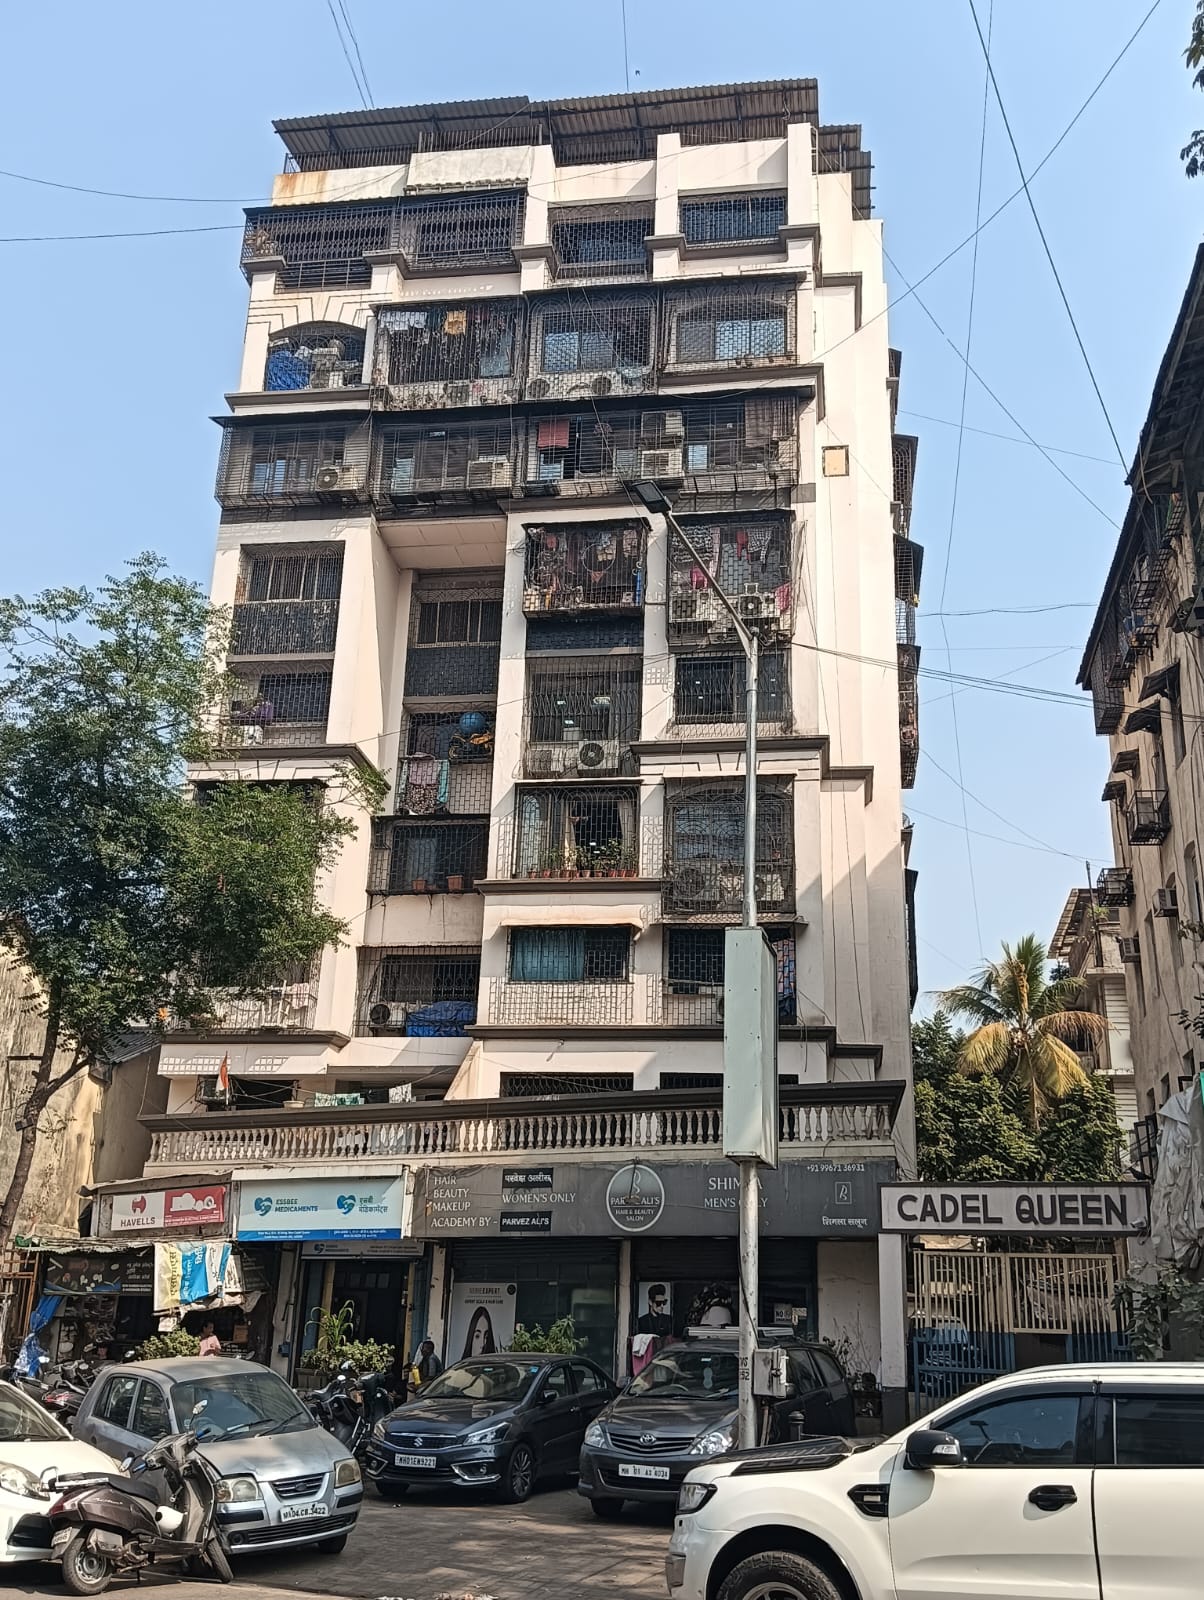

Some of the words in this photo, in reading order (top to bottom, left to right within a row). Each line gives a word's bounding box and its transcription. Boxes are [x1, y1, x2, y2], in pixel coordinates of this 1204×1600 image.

[434, 1175, 457, 1185] HAIR
[708, 1177, 763, 1190] SHIMA
[433, 1188, 470, 1199] BEAUTY
[502, 1193, 548, 1204] WOMEN'S
[549, 1192, 576, 1203] ONLY
[432, 1201, 471, 1212] MAKEUP
[704, 1197, 736, 1208] MEN'S
[274, 1205, 319, 1213] MEDICAMENTS
[897, 1193, 1003, 1224] CADEL
[1015, 1194, 1128, 1226] QUEEN
[120, 1216, 156, 1227] HAVELLS
[431, 1216, 477, 1228] ACADEMY
[479, 1216, 491, 1227] BY
[501, 1217, 530, 1226] PARVEZ
